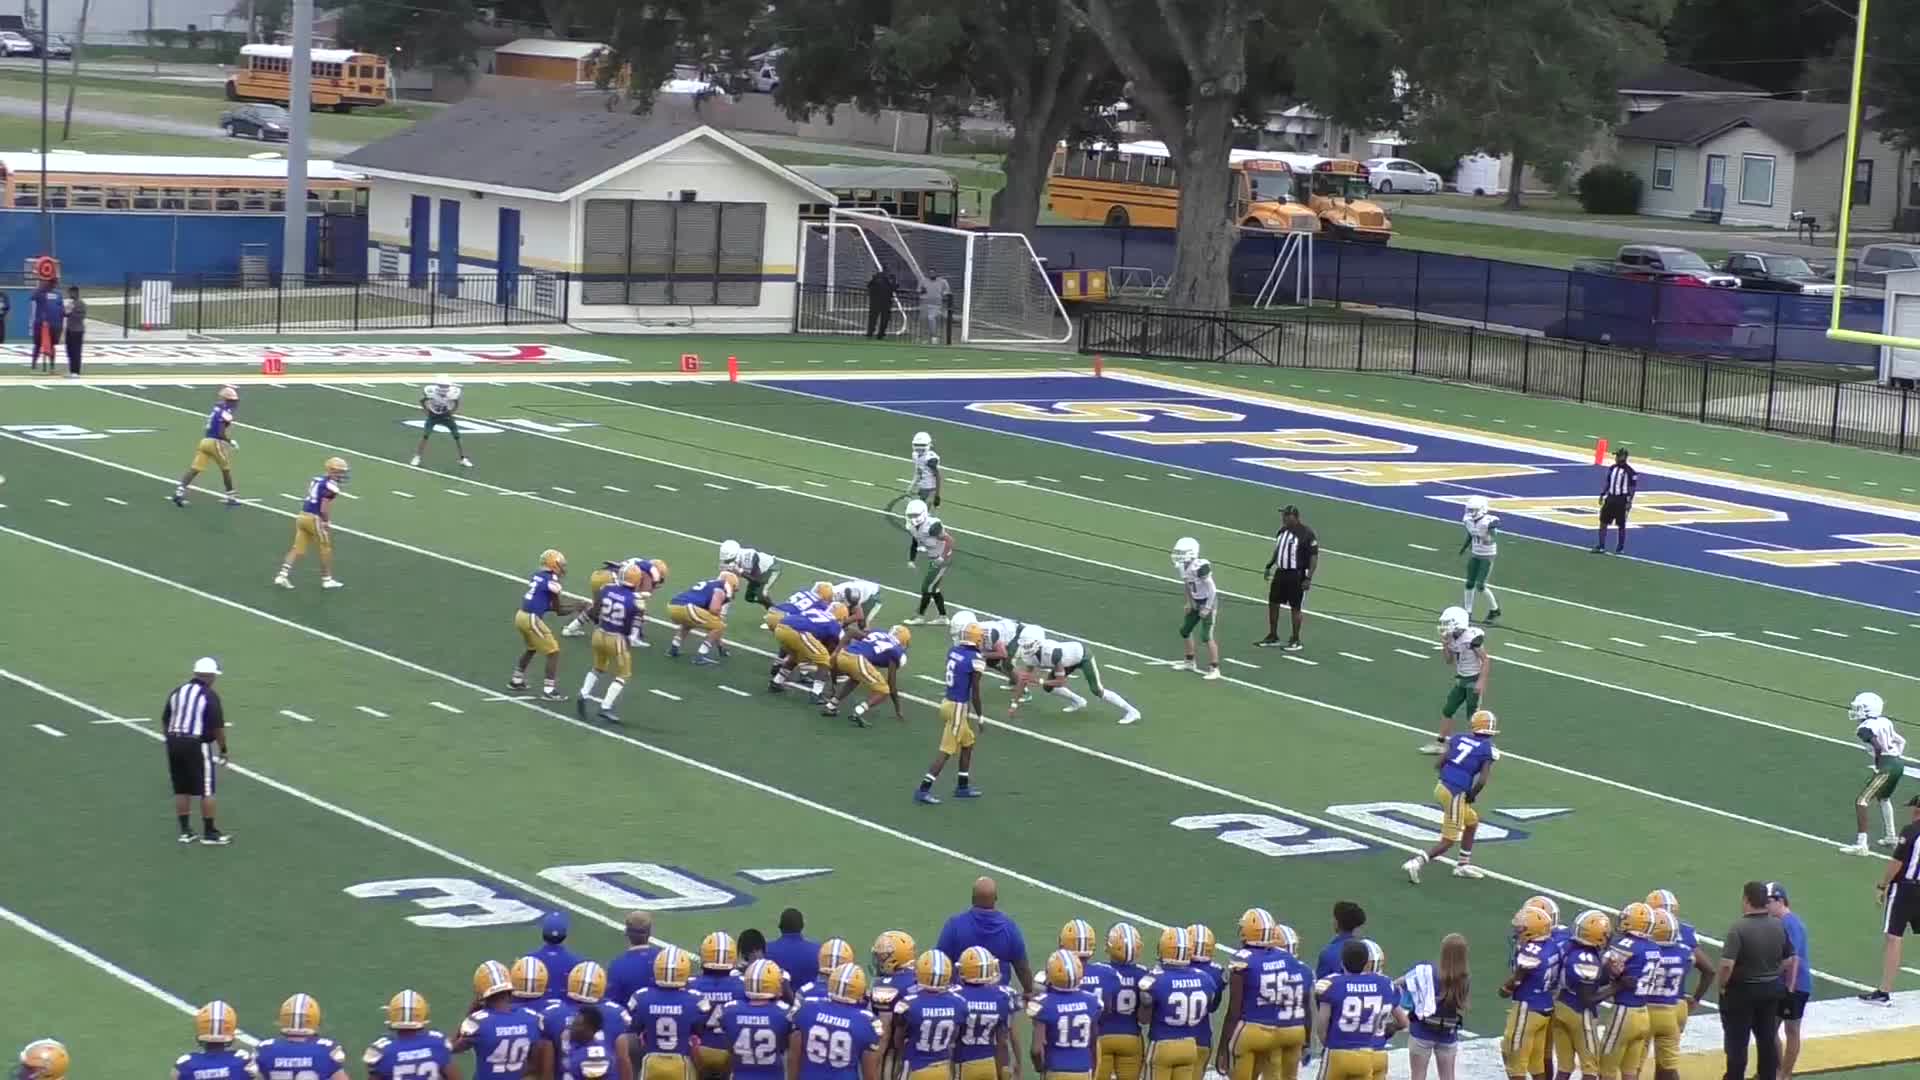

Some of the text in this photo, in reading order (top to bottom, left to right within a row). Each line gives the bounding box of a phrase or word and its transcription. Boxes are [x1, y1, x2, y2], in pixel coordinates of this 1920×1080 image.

[684, 356, 698, 370] G
[601, 597, 626, 623] 22
[1451, 742, 1473, 764] 7
[1169, 801, 1510, 857] 20
[343, 861, 736, 929] 30
[1171, 978, 1202, 989] SPARTANS
[1346, 982, 1378, 993] SPARTANS
[649, 1003, 684, 1016] SPARTANS
[922, 1007, 956, 1018] SPARTANS
[967, 1000, 998, 1012] SPARTANS
[1056, 1001, 1089, 1013] SPARTANS
[1164, 990, 1208, 1027] 30
[736, 1014, 771, 1026] SPARTANS
[816, 1012, 851, 1028] SPARTANS
[960, 1013, 1001, 1046] 17
[1055, 1014, 1092, 1049] 13
[655, 1016, 679, 1050] 9
[915, 1019, 955, 1053] 10
[485, 1037, 532, 1074] 40
[732, 1027, 778, 1066] 42
